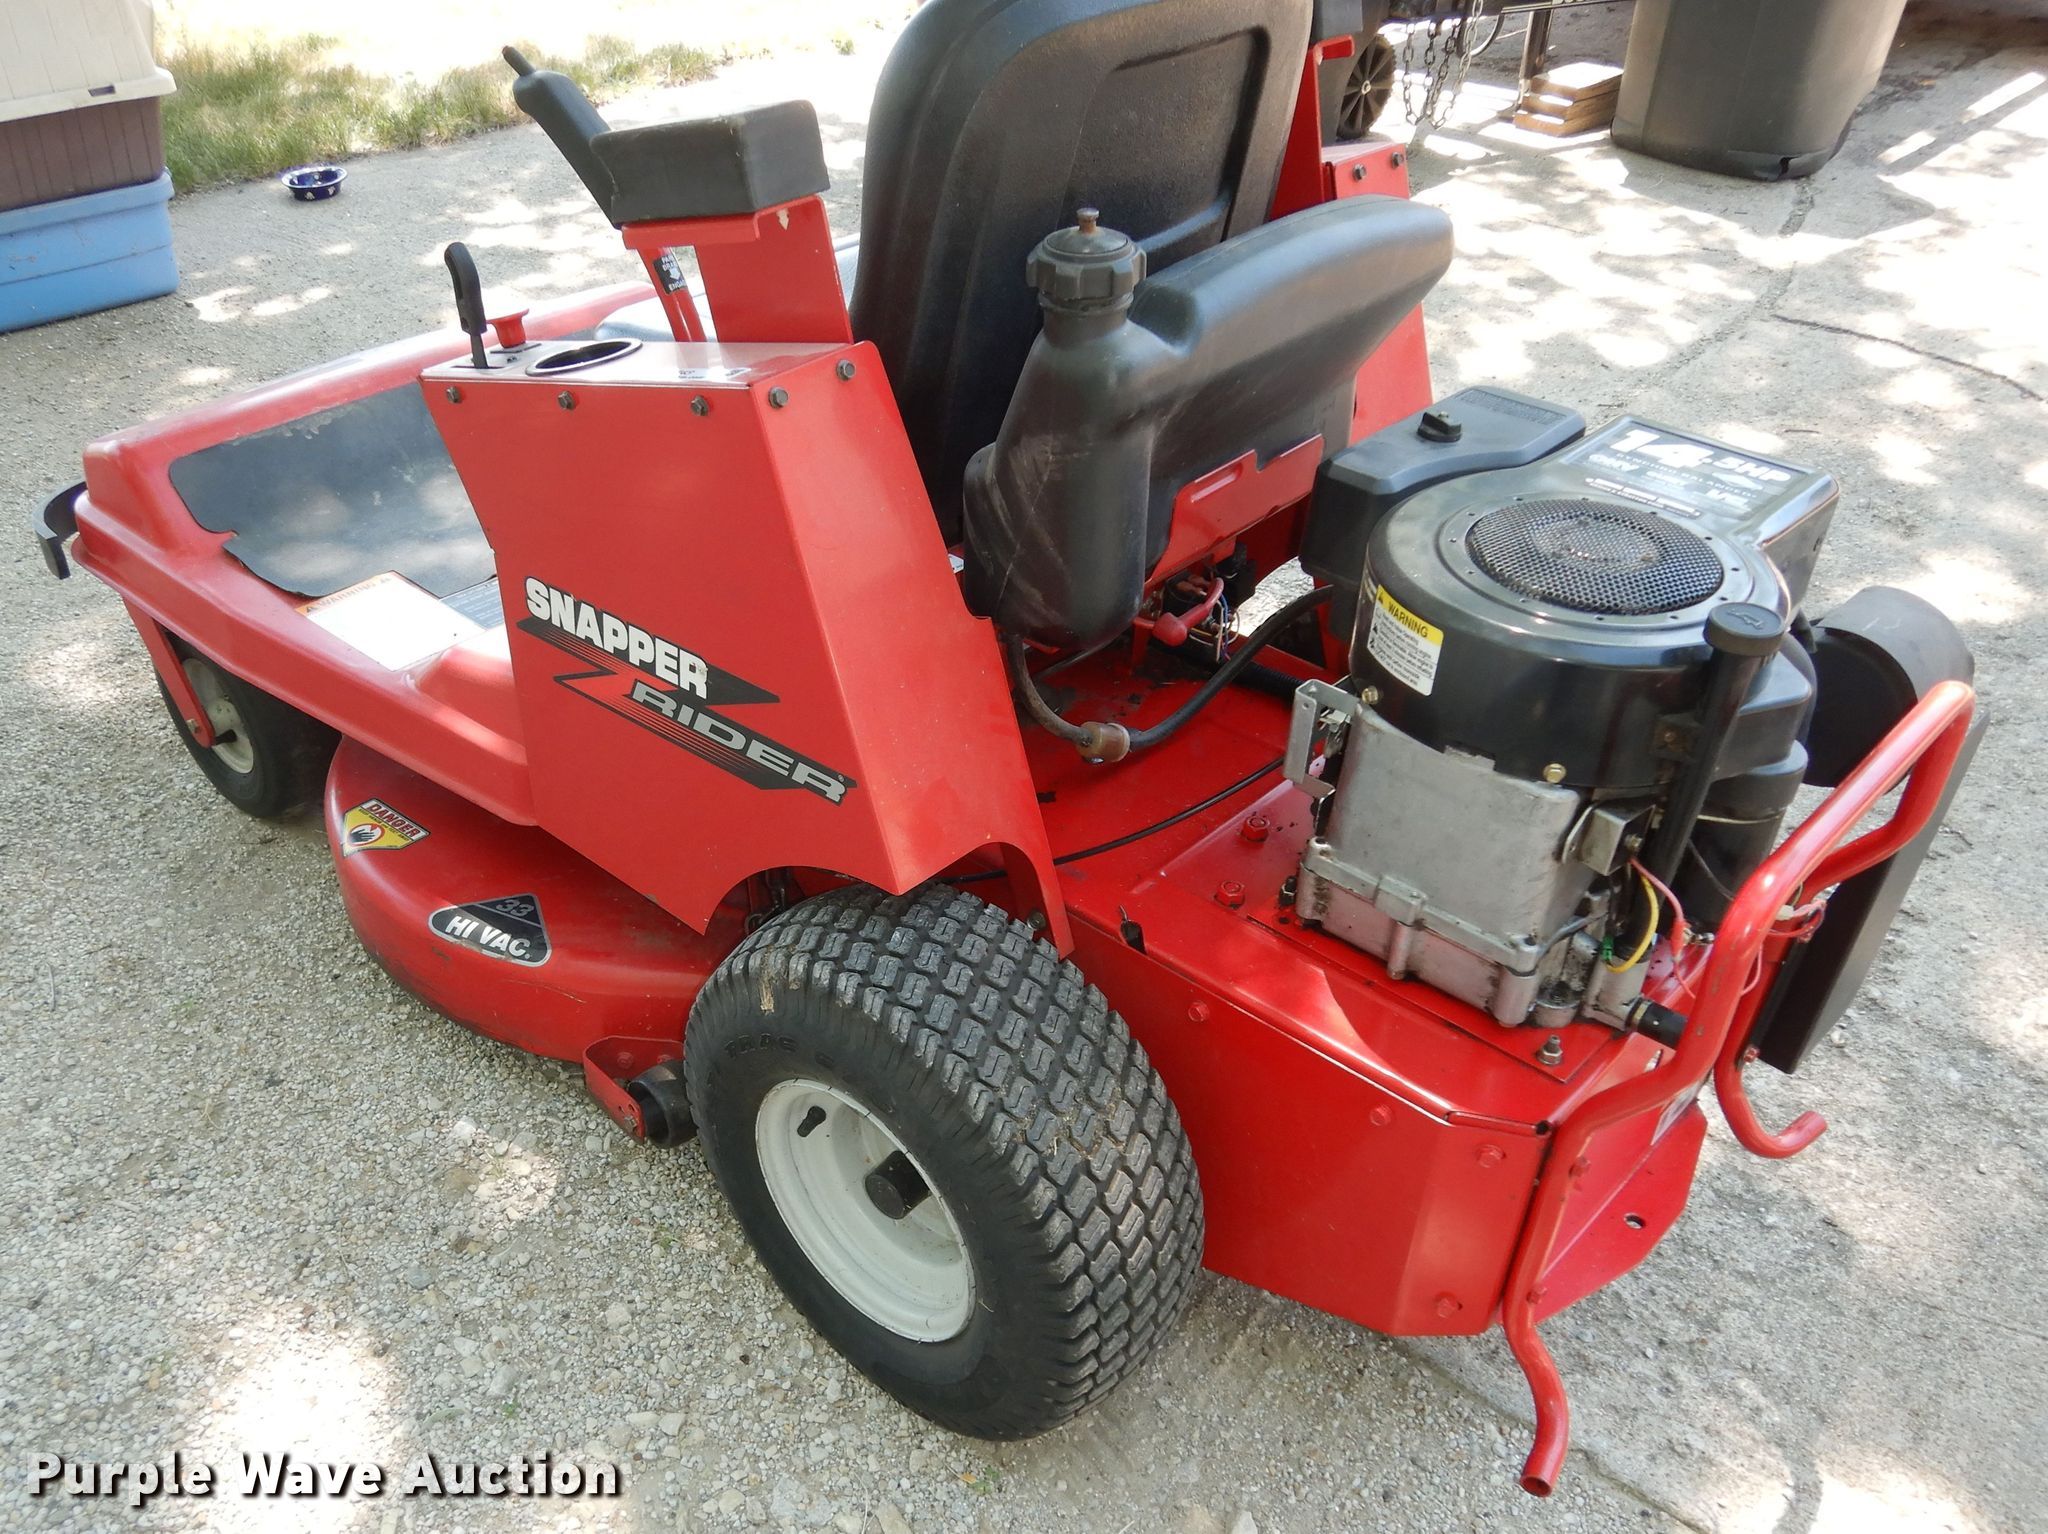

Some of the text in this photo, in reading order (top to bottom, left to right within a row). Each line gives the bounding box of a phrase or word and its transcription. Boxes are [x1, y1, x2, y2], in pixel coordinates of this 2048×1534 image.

[1610, 429, 1791, 482] 14.5HP
[526, 576, 708, 699] SNAPPER
[1388, 602, 1429, 638] WARNING
[632, 681, 847, 802] RIDER
[365, 803, 421, 838] DANGER
[496, 899, 535, 917] 33
[445, 916, 479, 939] HI
